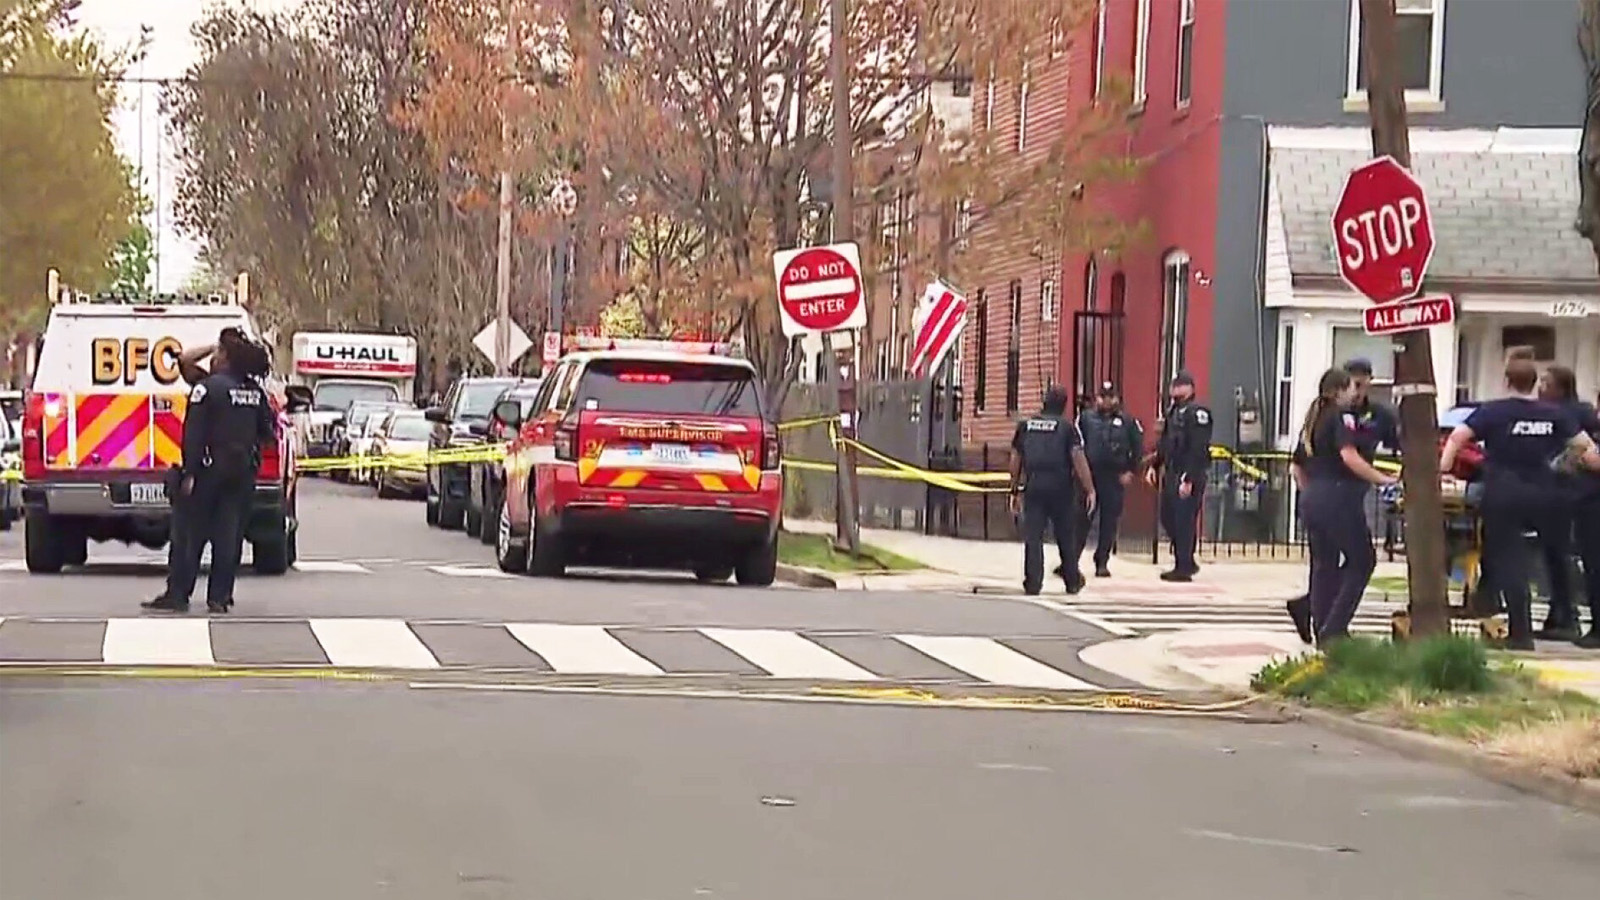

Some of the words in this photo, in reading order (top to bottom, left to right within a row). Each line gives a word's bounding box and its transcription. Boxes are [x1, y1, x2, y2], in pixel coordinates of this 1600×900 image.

[1342, 197, 1420, 270] STOP
[789, 266, 809, 281] DO
[818, 261, 845, 277] NOT
[800, 299, 845, 317] ENTER
[1373, 309, 1404, 329] ALL
[92, 336, 183, 386] BFC
[316, 345, 400, 362] U-HAUL
[649, 427, 724, 441] SUPERVISOR
